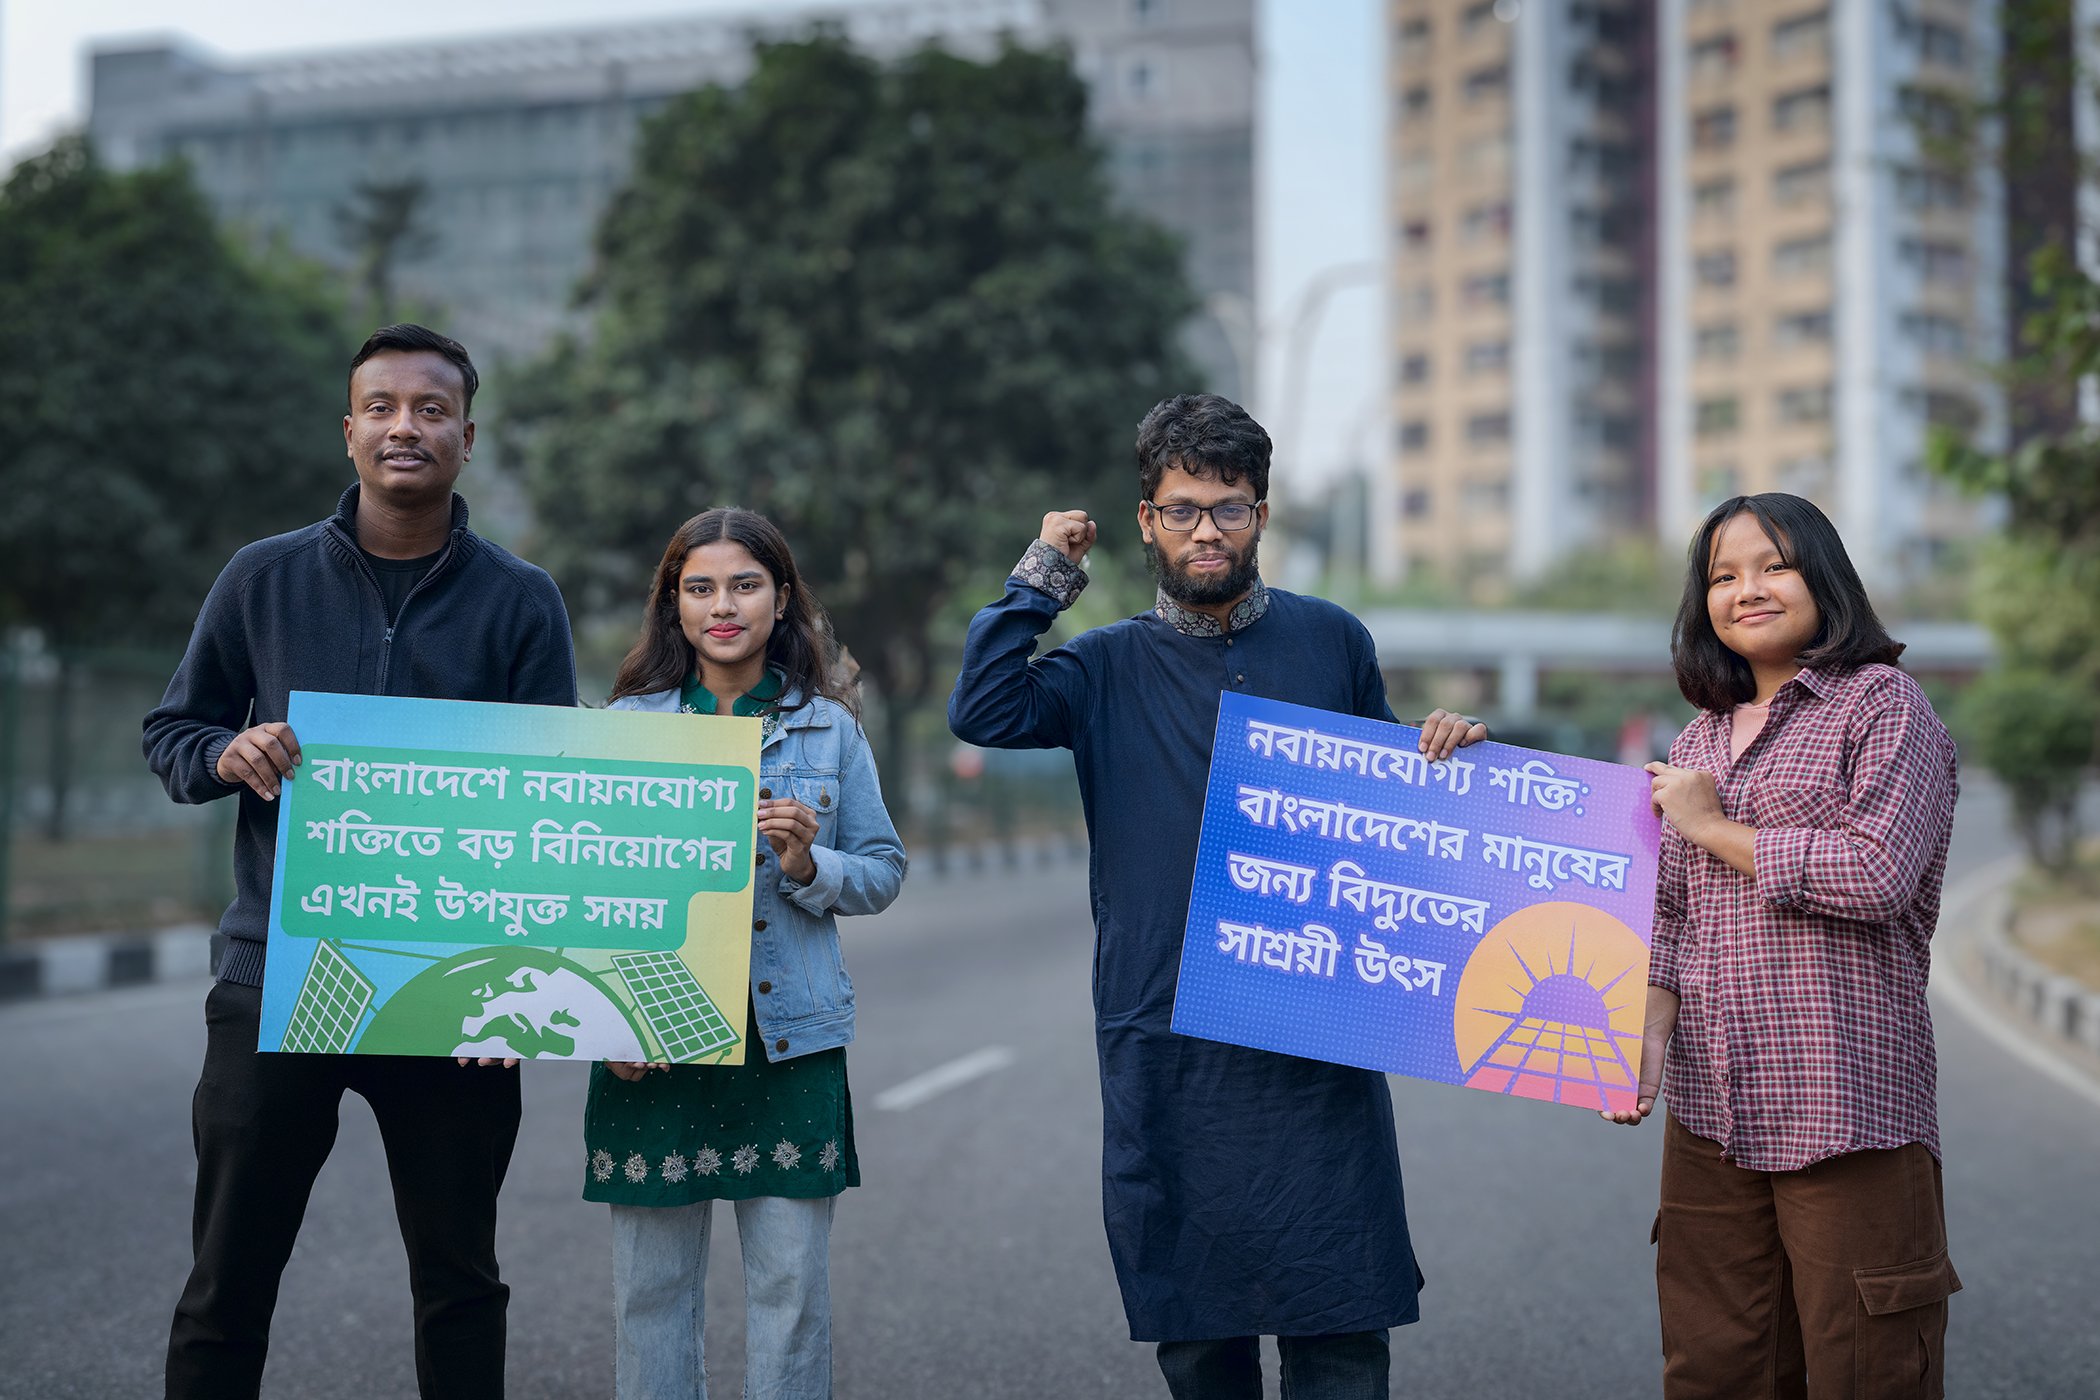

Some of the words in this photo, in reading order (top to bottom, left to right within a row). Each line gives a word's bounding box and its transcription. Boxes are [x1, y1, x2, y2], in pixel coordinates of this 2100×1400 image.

[311, 758, 509, 799] বাংলাদেশে
[523, 769, 739, 811] নবায়নযোগ্য
[306, 809, 444, 857] শক্তিতে
[457, 828, 516, 869] বড়
[530, 819, 735, 871] বিনিয়োগের
[1238, 785, 1468, 861] বাংলাদেশের
[1482, 832, 1630, 890] মানুষের
[301, 874, 421, 923] এখনই
[435, 876, 570, 937] উপযুক্ত
[584, 895, 668, 930] সময়
[1229, 852, 1316, 902] জন্য
[1328, 860, 1490, 934] বিদ্যুতের
[1217, 920, 1341, 978] সাশ্রয়ী
[1354, 933, 1446, 996] উৎস
